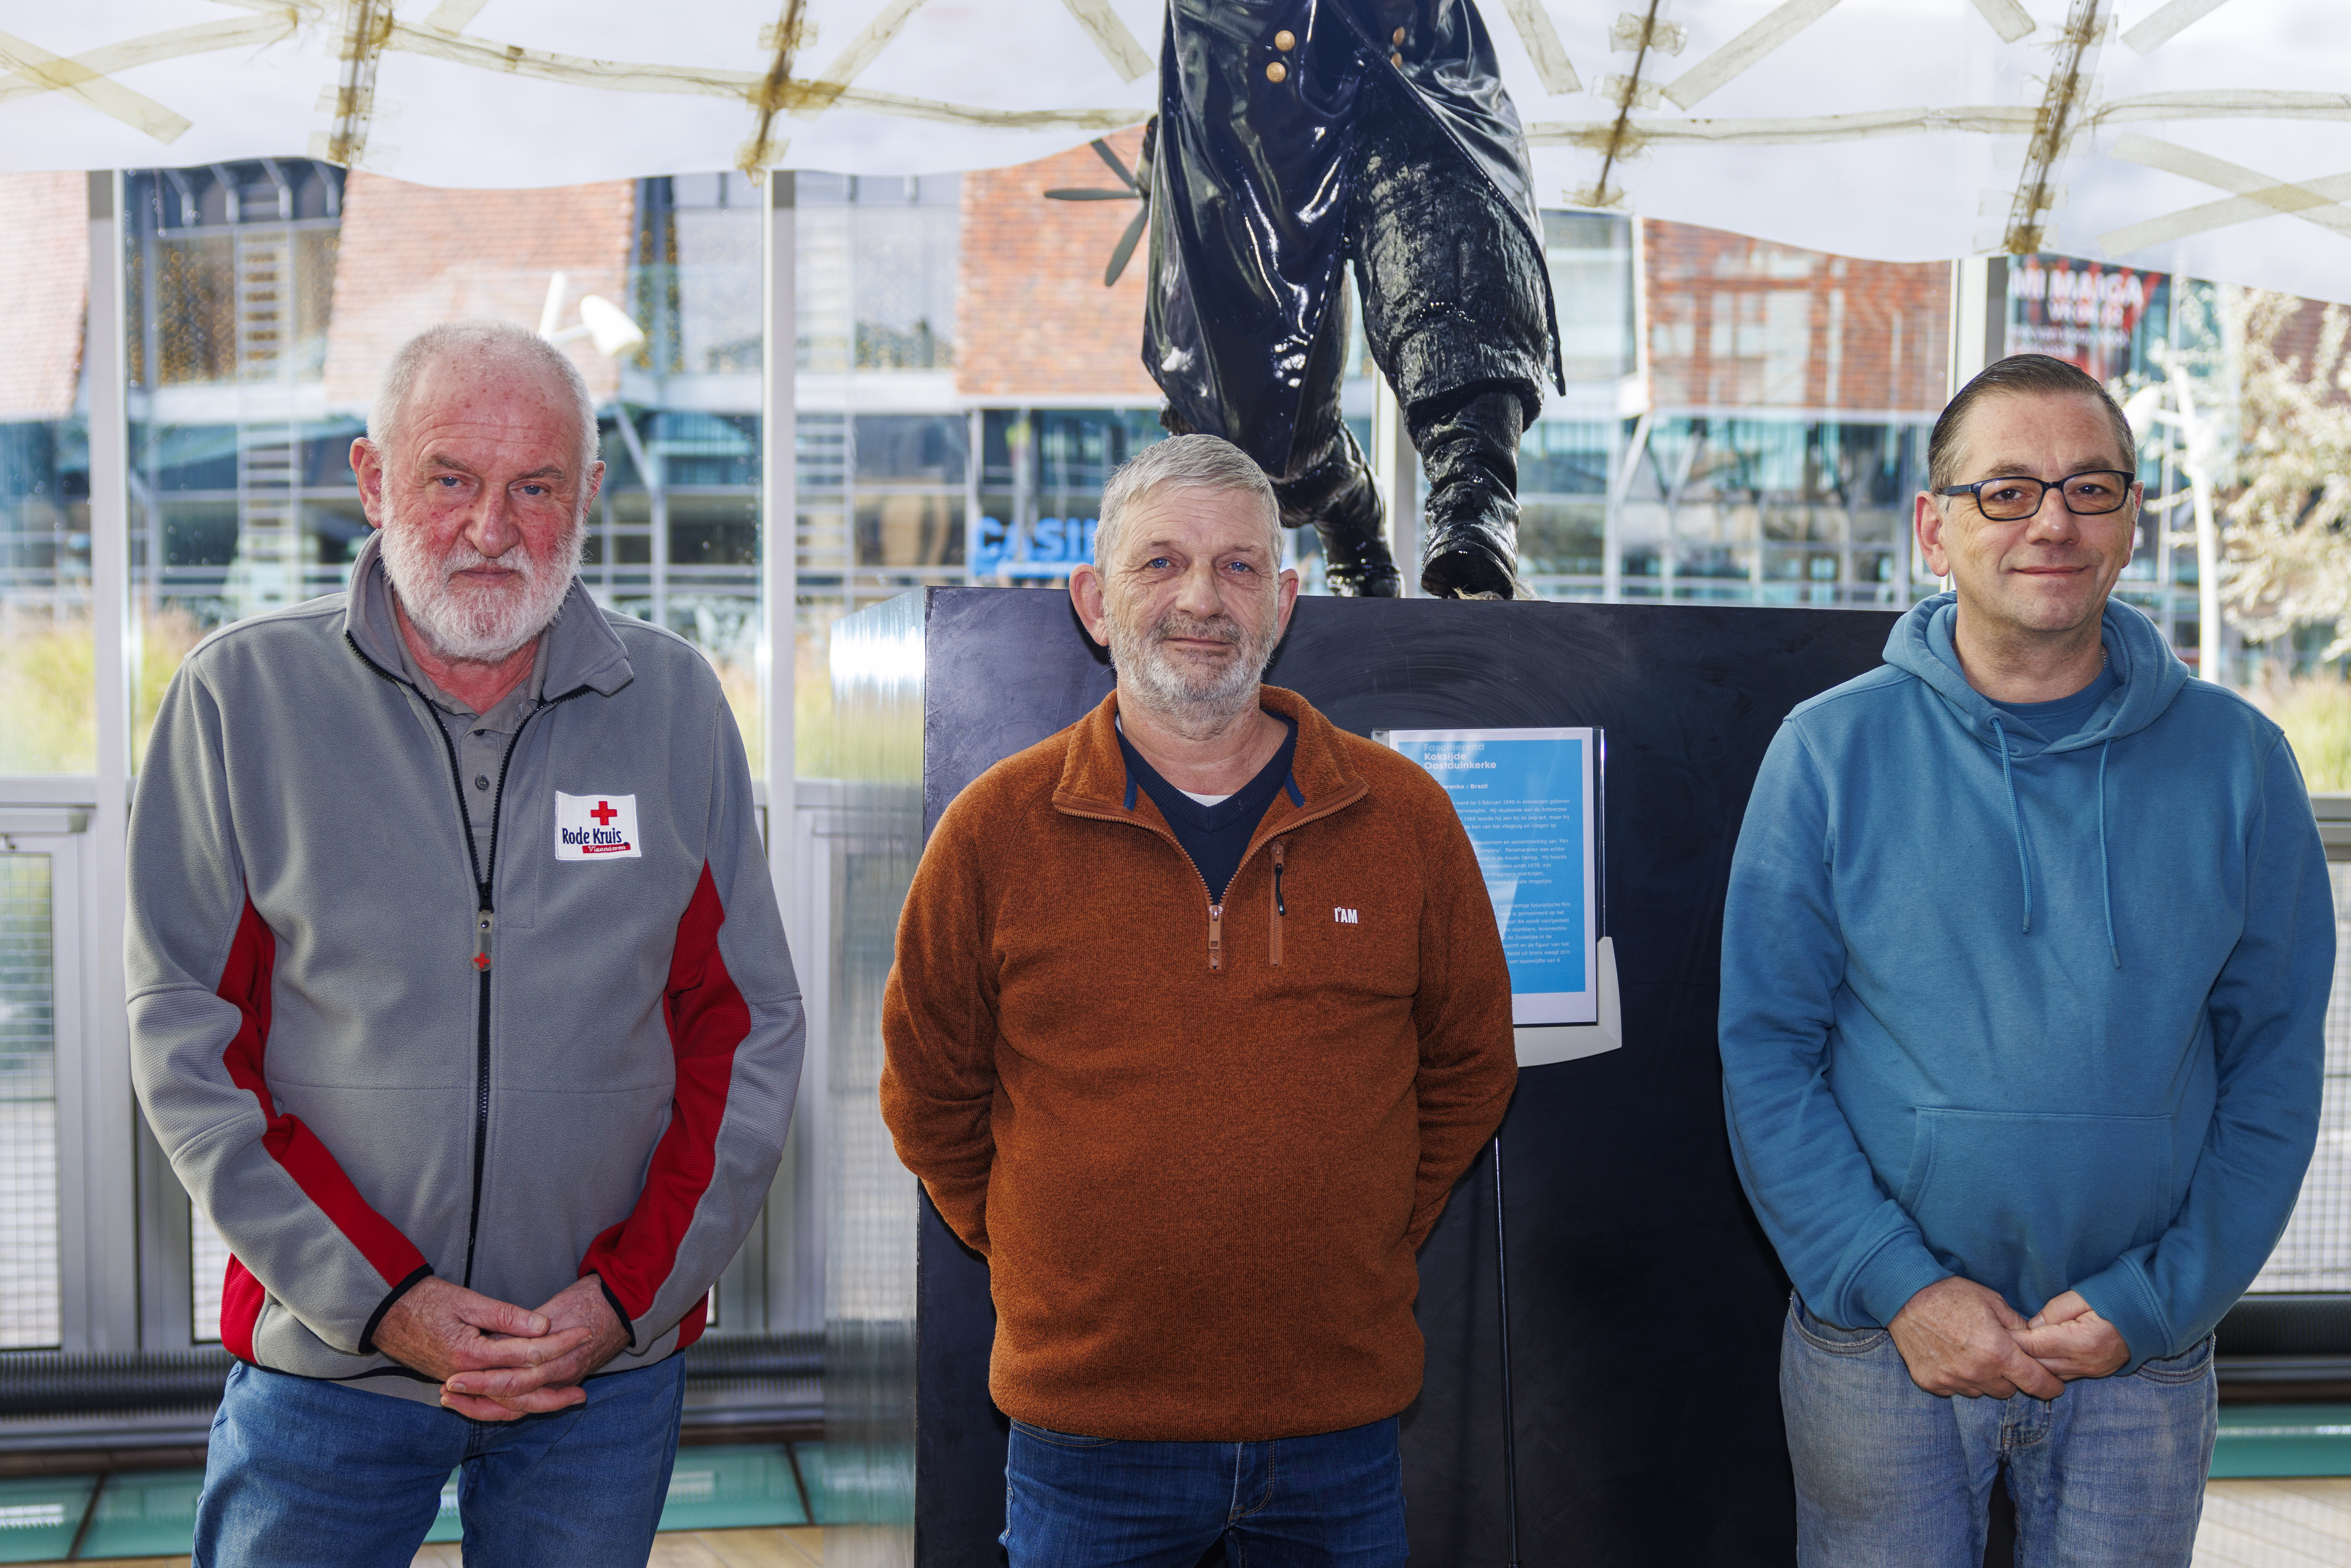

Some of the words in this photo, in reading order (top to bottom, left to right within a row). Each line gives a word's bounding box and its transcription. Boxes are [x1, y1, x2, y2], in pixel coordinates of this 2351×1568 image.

[976, 516, 1098, 560] CASI
[1424, 753, 1466, 761] Koksijde
[562, 827, 590, 844] Rode
[593, 827, 622, 844] Kruis
